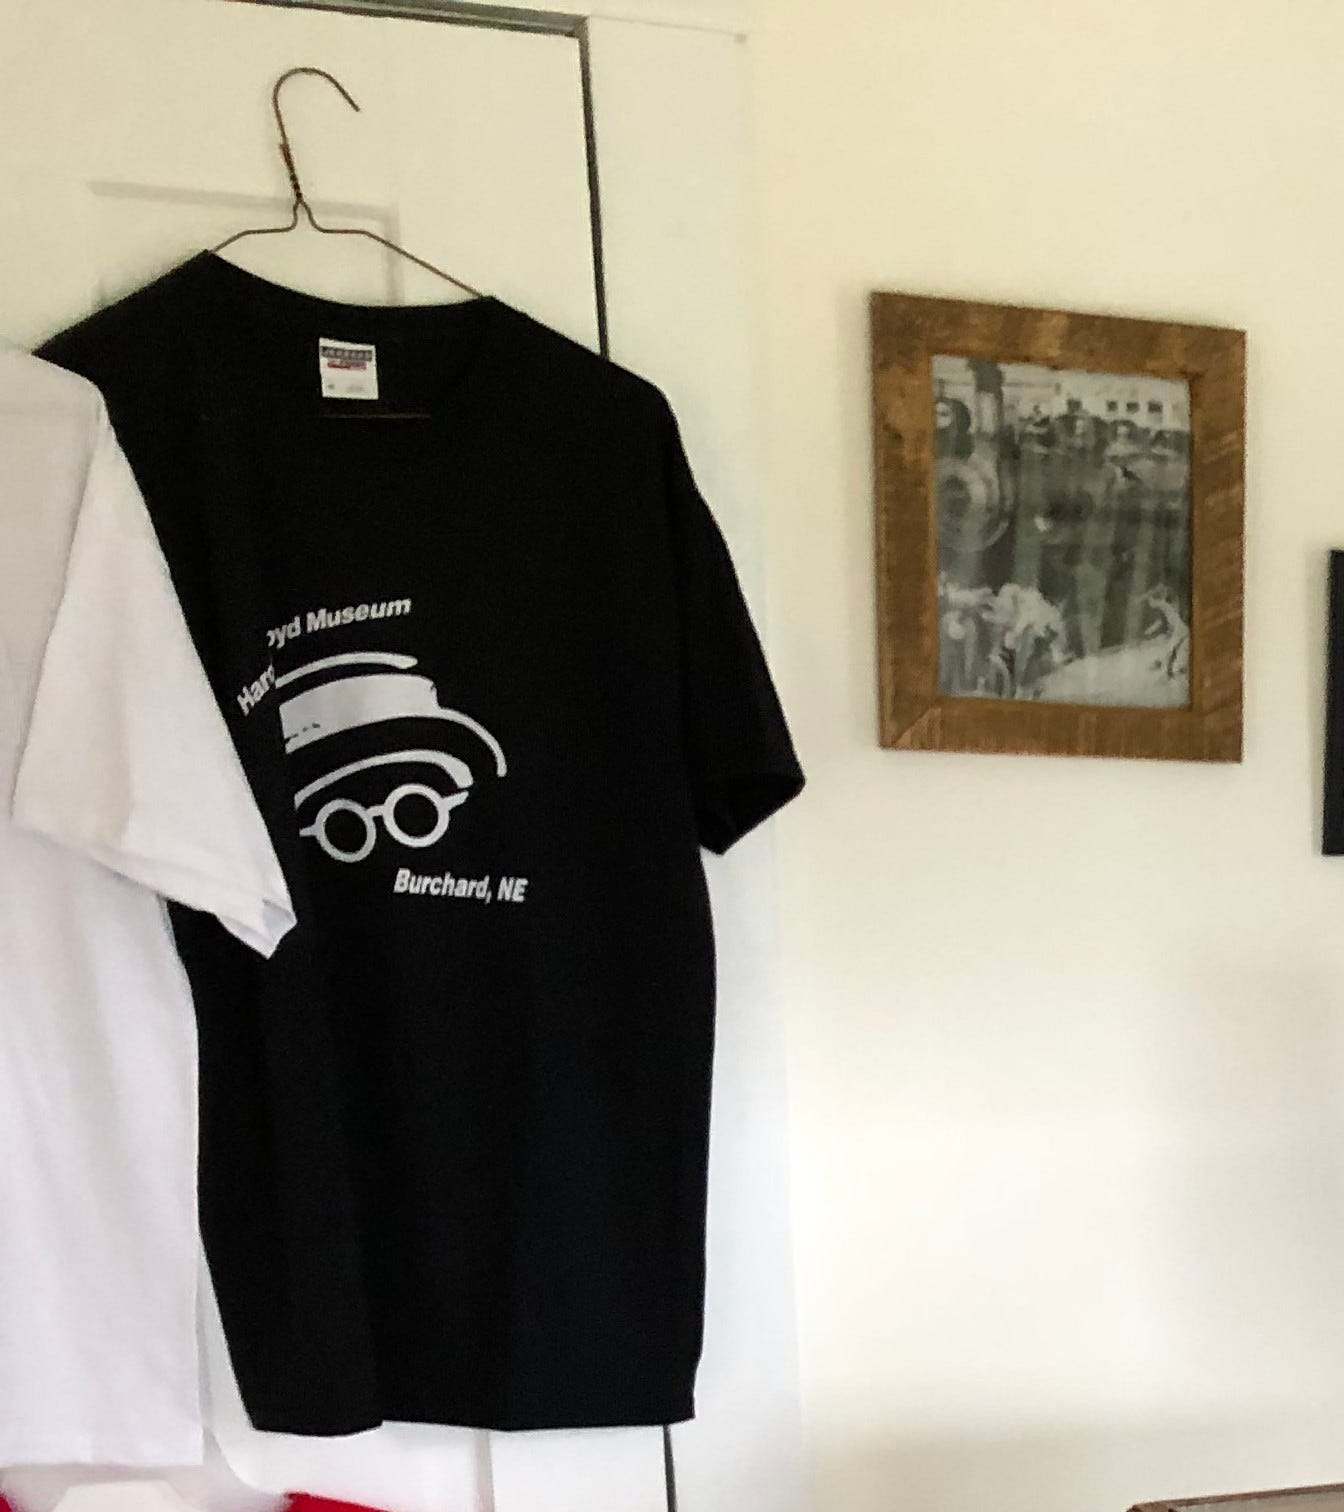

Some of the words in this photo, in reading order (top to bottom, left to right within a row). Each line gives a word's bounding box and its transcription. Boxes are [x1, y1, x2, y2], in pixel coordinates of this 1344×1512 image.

[305, 598, 412, 633] Museum
[393, 867, 492, 904] Burchard,
[496, 876, 529, 902] NE
